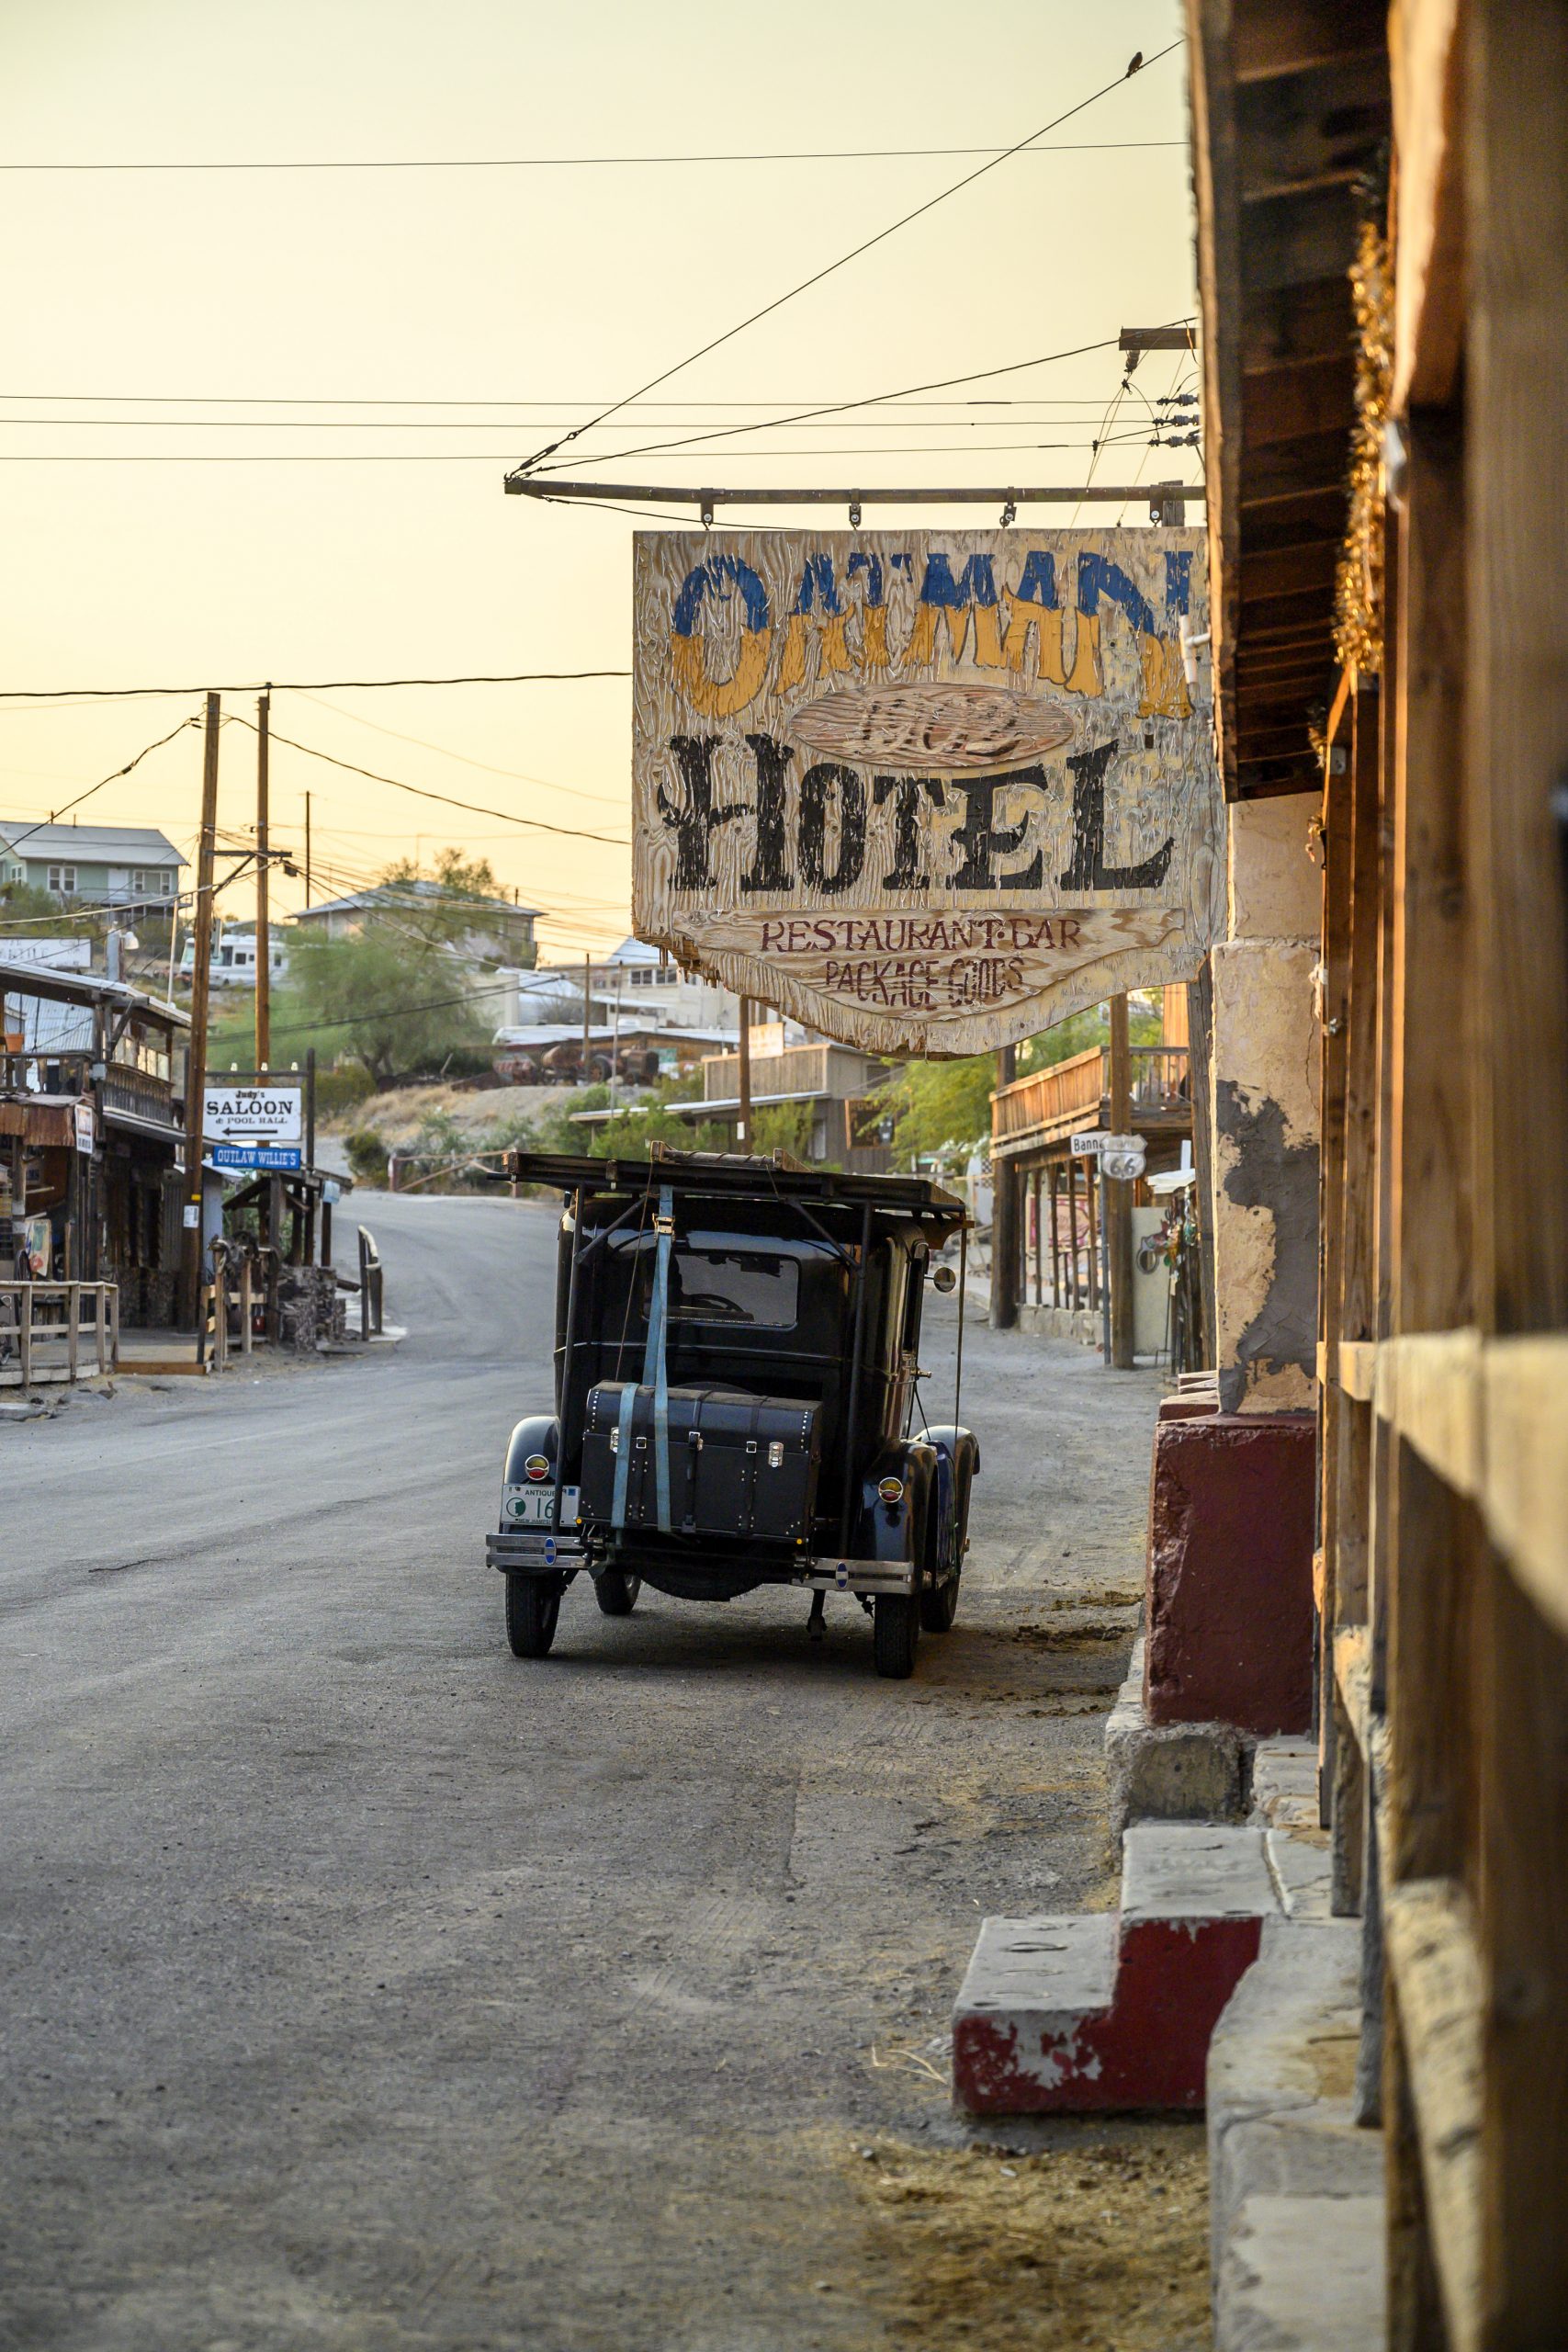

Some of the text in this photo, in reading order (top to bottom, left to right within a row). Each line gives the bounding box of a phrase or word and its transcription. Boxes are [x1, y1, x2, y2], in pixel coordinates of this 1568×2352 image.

[671, 551, 1194, 719] OATMAN
[658, 735, 1176, 896] HOTEL
[826, 956, 1025, 1009] PACKAGE GOODS
[235, 1090, 265, 1100] Judy's
[206, 1101, 293, 1115] SALOON
[227, 1116, 255, 1125] POOL
[259, 1116, 288, 1125] HALL
[217, 1148, 297, 1167] OUTLAW WILLIE'S
[1110, 1157, 1136, 1176] 66
